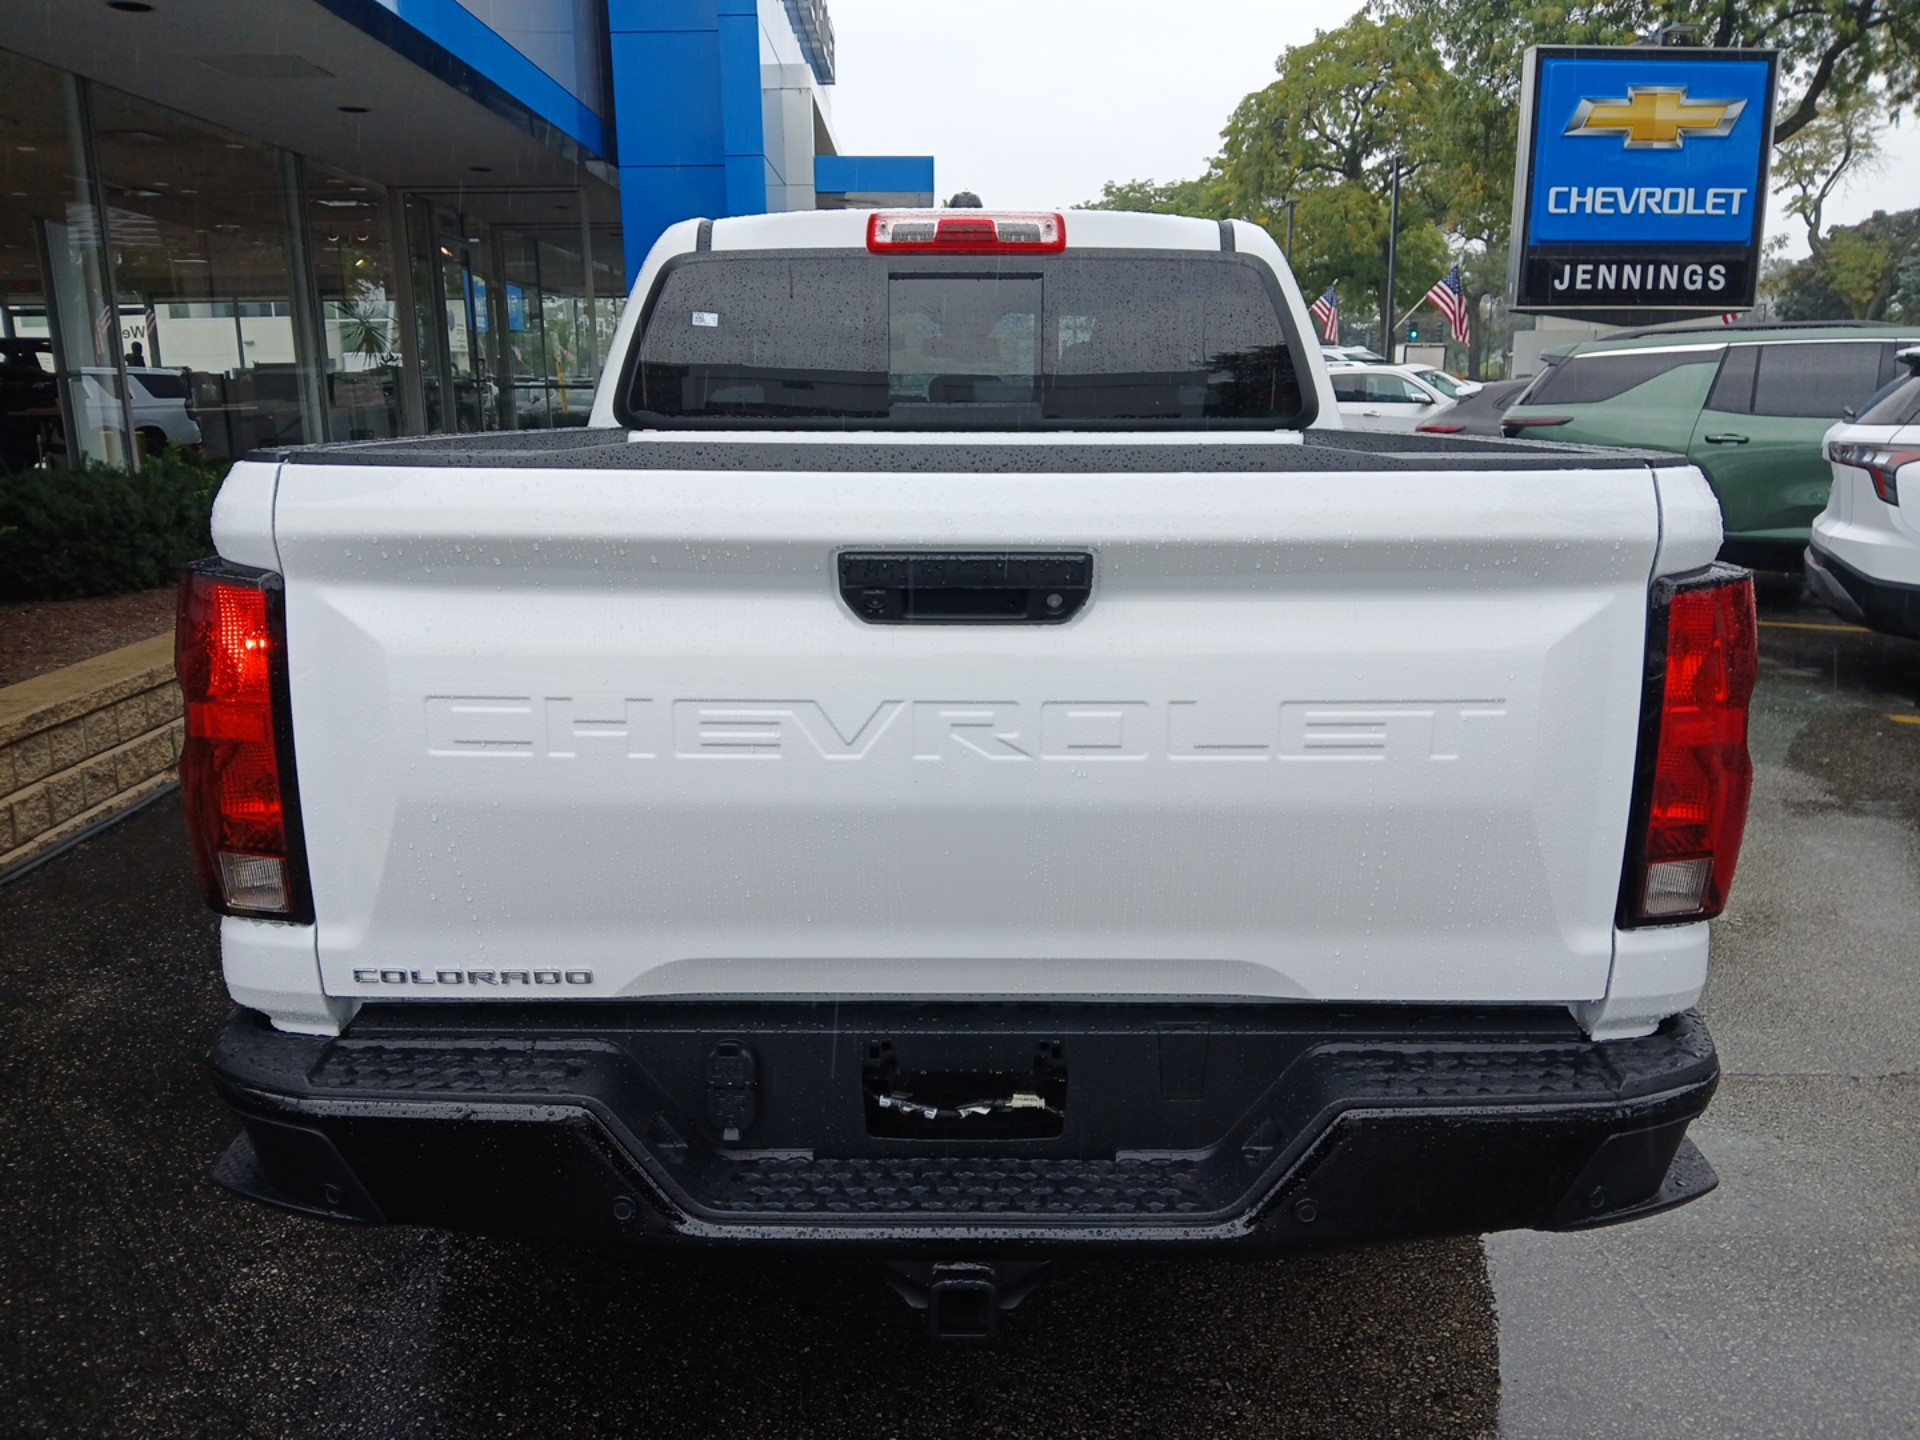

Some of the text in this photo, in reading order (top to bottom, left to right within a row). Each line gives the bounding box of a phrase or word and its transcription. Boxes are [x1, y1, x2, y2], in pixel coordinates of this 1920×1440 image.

[1548, 187, 1747, 214] CHEVROLET
[1554, 264, 1726, 290] JENNINGS
[424, 695, 1506, 761] CHEVROLET
[353, 968, 593, 985] COLORADO
